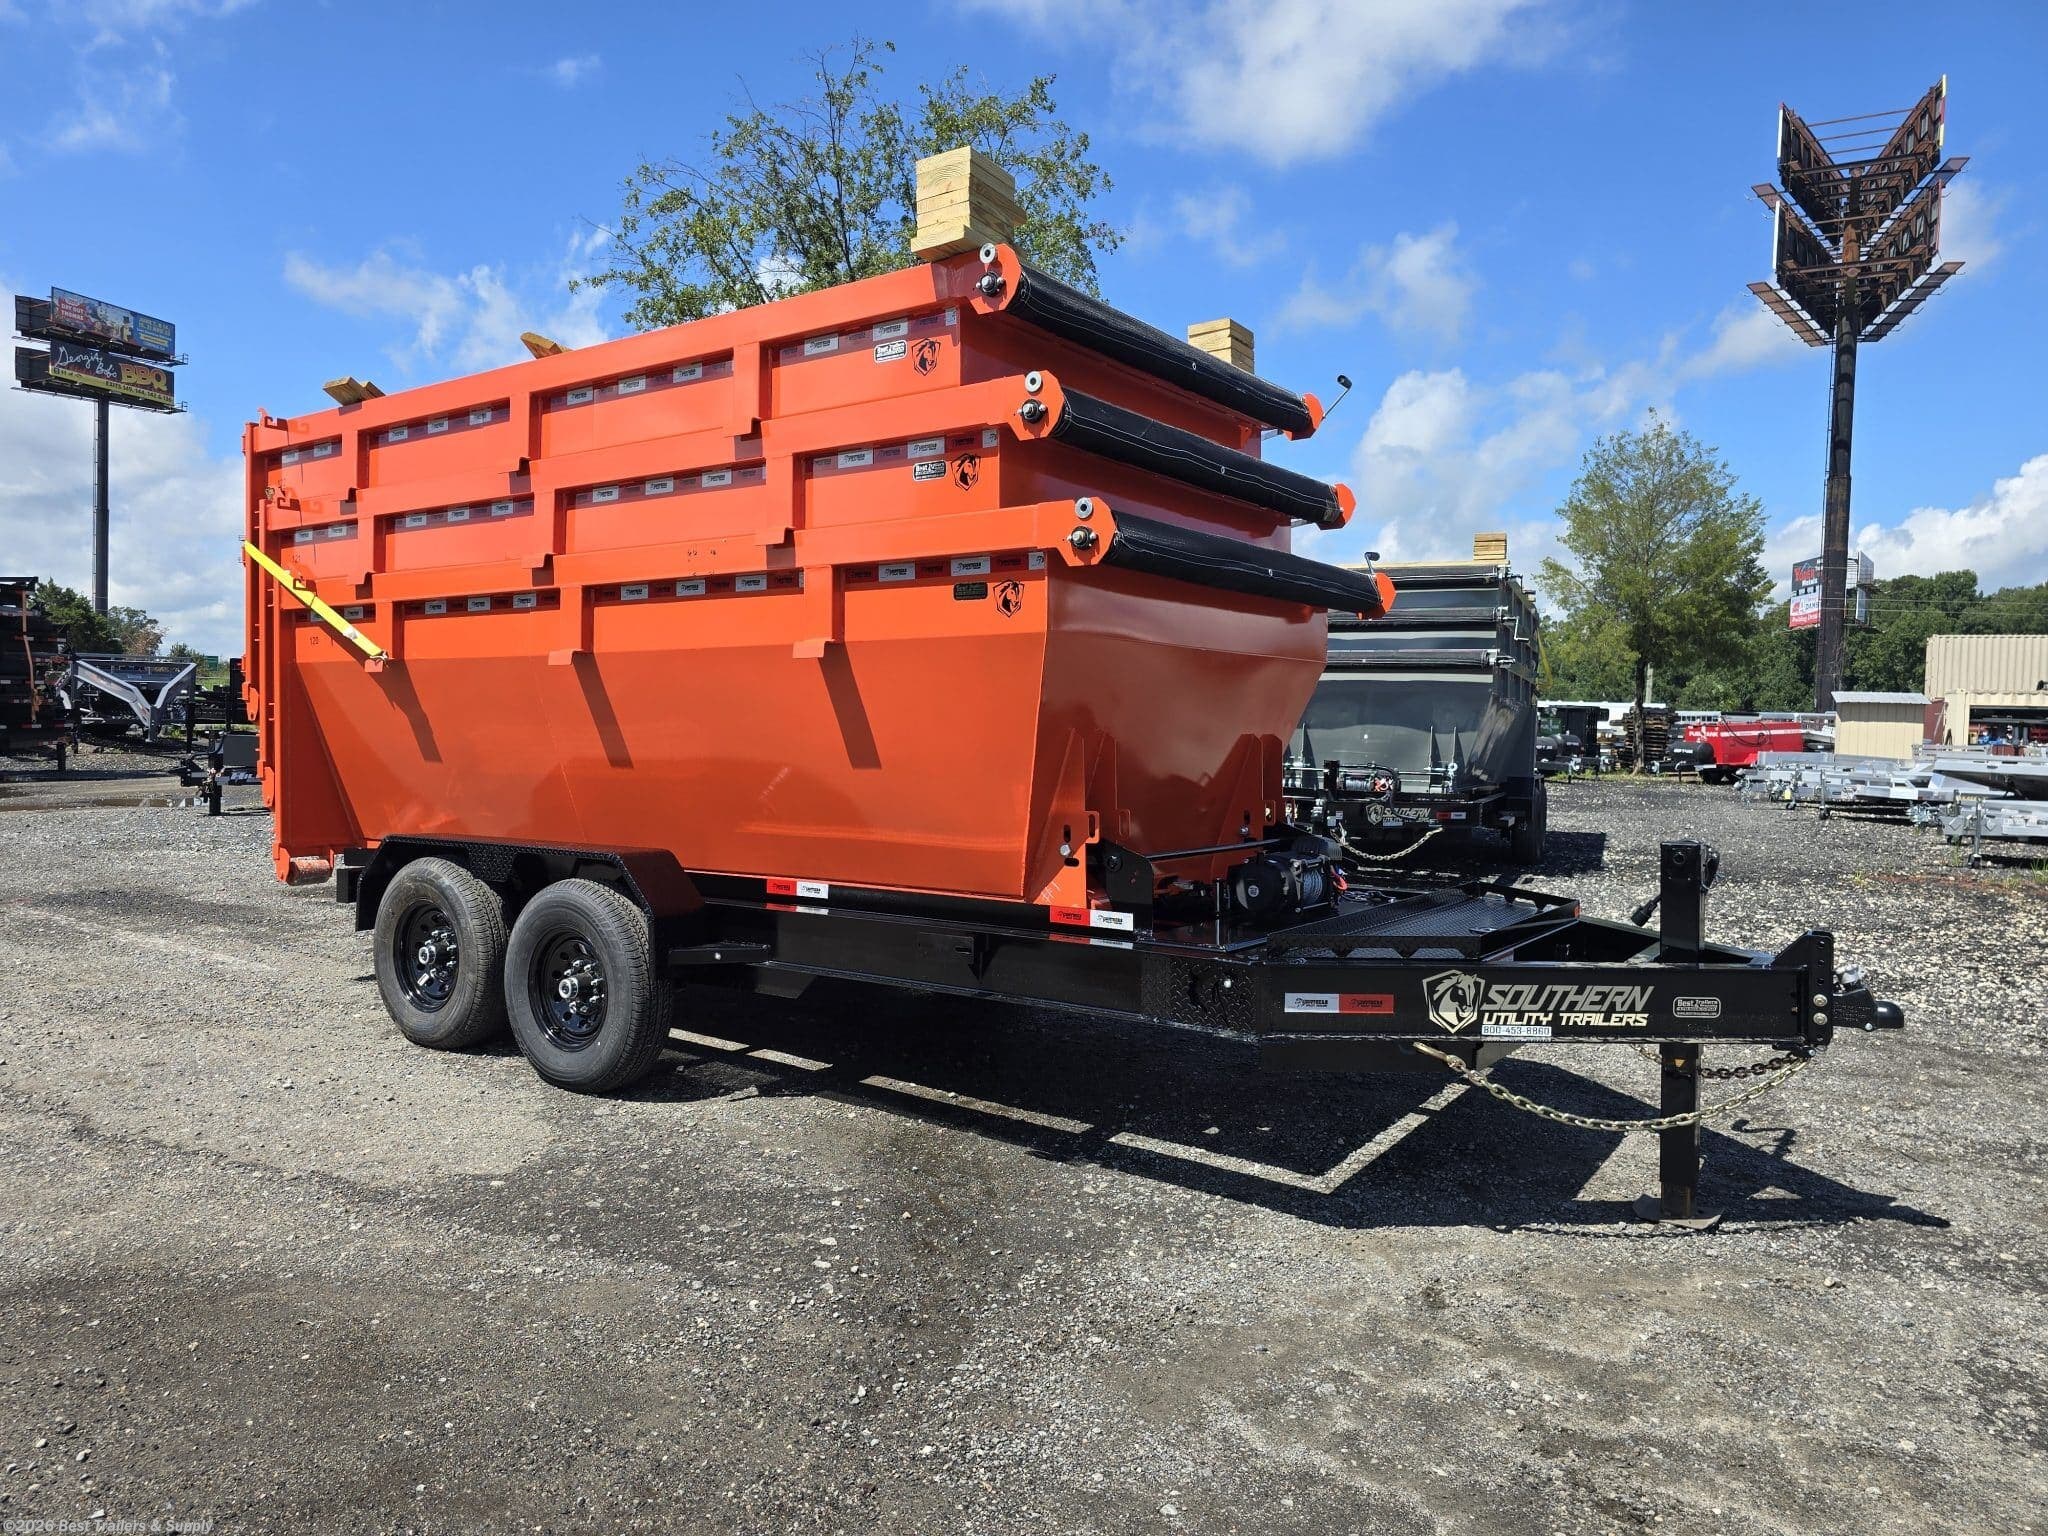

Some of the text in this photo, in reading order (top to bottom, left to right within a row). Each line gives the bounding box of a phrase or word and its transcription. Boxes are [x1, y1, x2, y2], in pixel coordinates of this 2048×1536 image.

[119, 363, 168, 391] BBQ
[1480, 984, 1655, 1012] SOUTHERN
[1482, 1012, 1650, 1027] UTILITY TRAILERS
